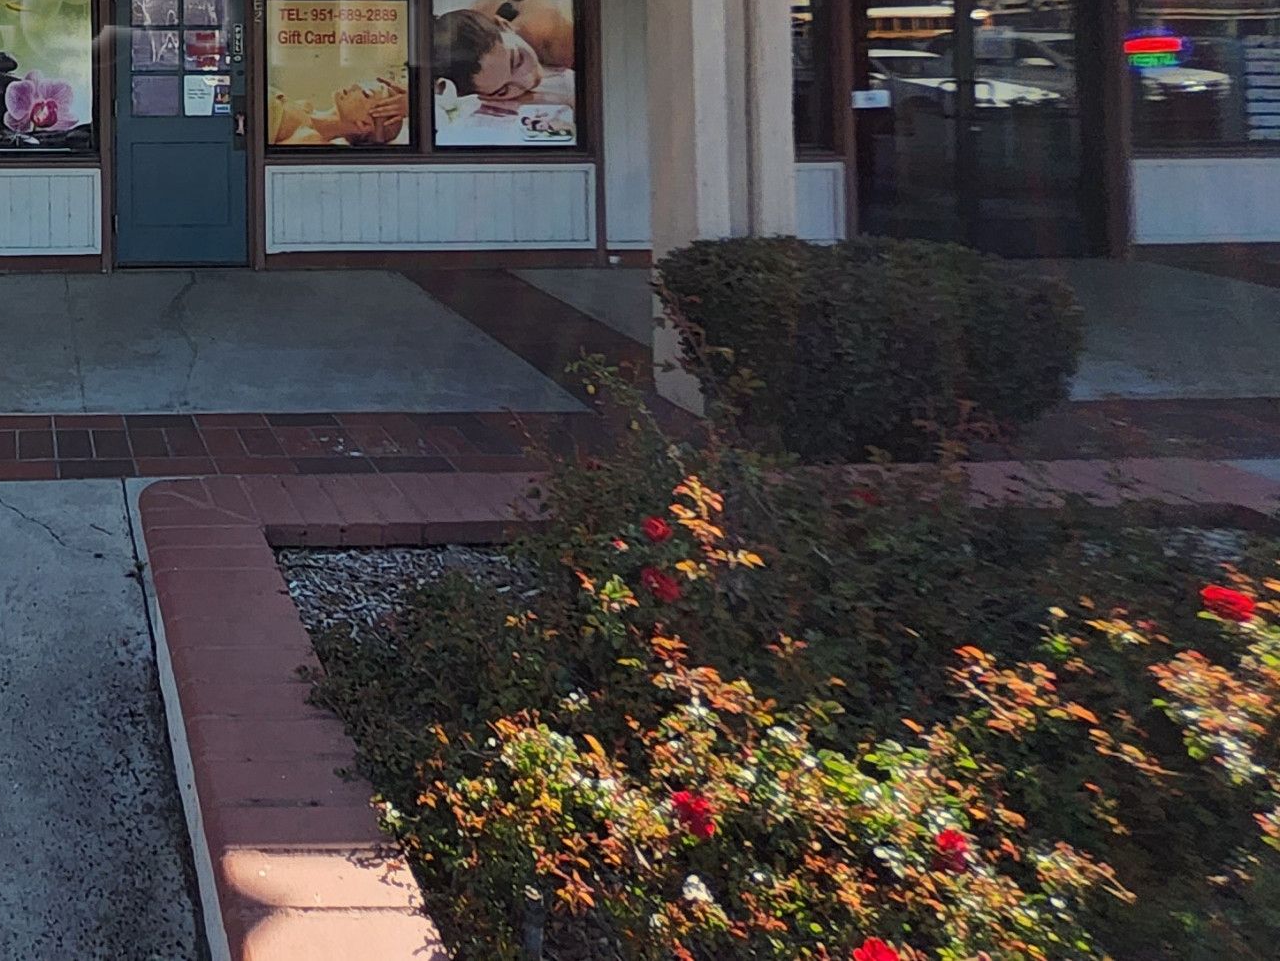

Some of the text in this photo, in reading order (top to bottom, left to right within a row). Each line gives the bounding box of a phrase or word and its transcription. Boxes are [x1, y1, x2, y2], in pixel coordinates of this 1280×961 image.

[279, 8, 308, 21] TEL:
[278, 30, 398, 44] Gift Card Available
